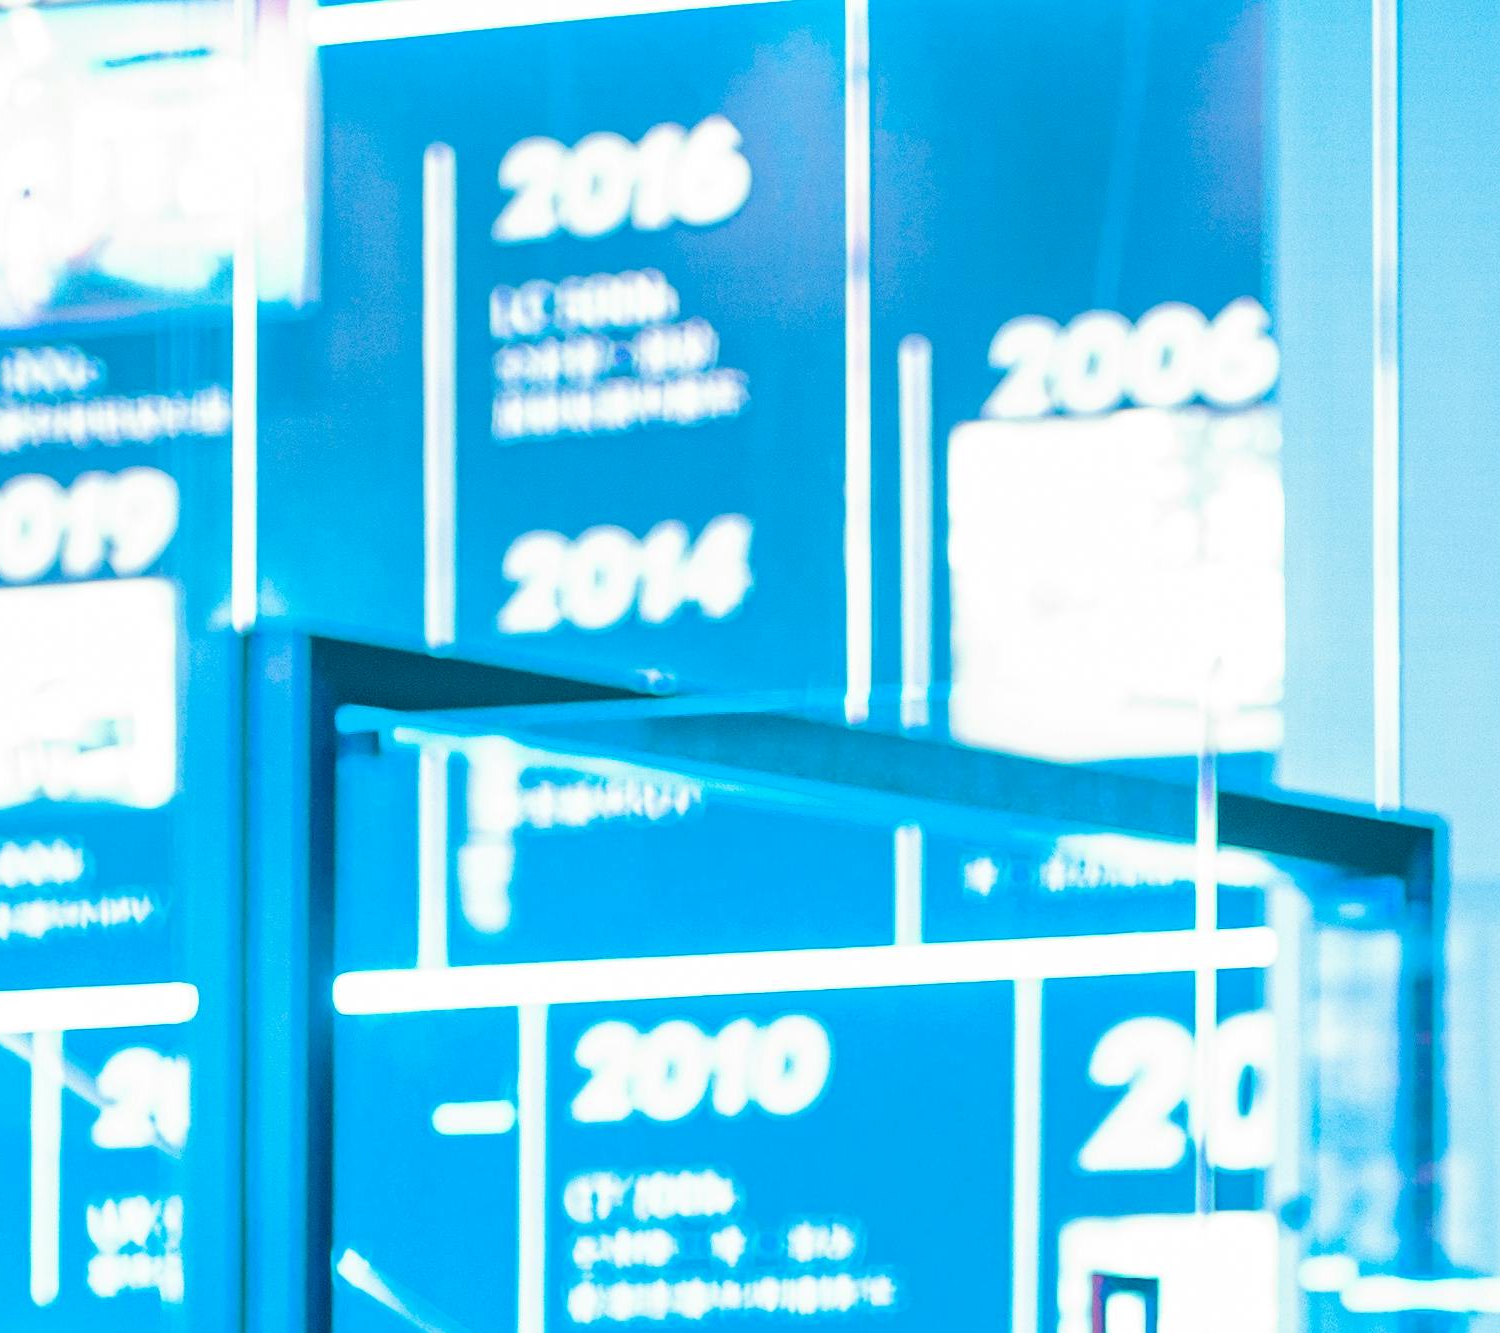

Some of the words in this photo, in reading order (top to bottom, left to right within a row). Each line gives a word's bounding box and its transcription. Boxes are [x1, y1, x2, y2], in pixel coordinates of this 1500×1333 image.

[492, 115, 752, 242] 2016
[984, 298, 1279, 416] 2006
[496, 515, 754, 634] 2014
[570, 1014, 833, 1124] 2010
